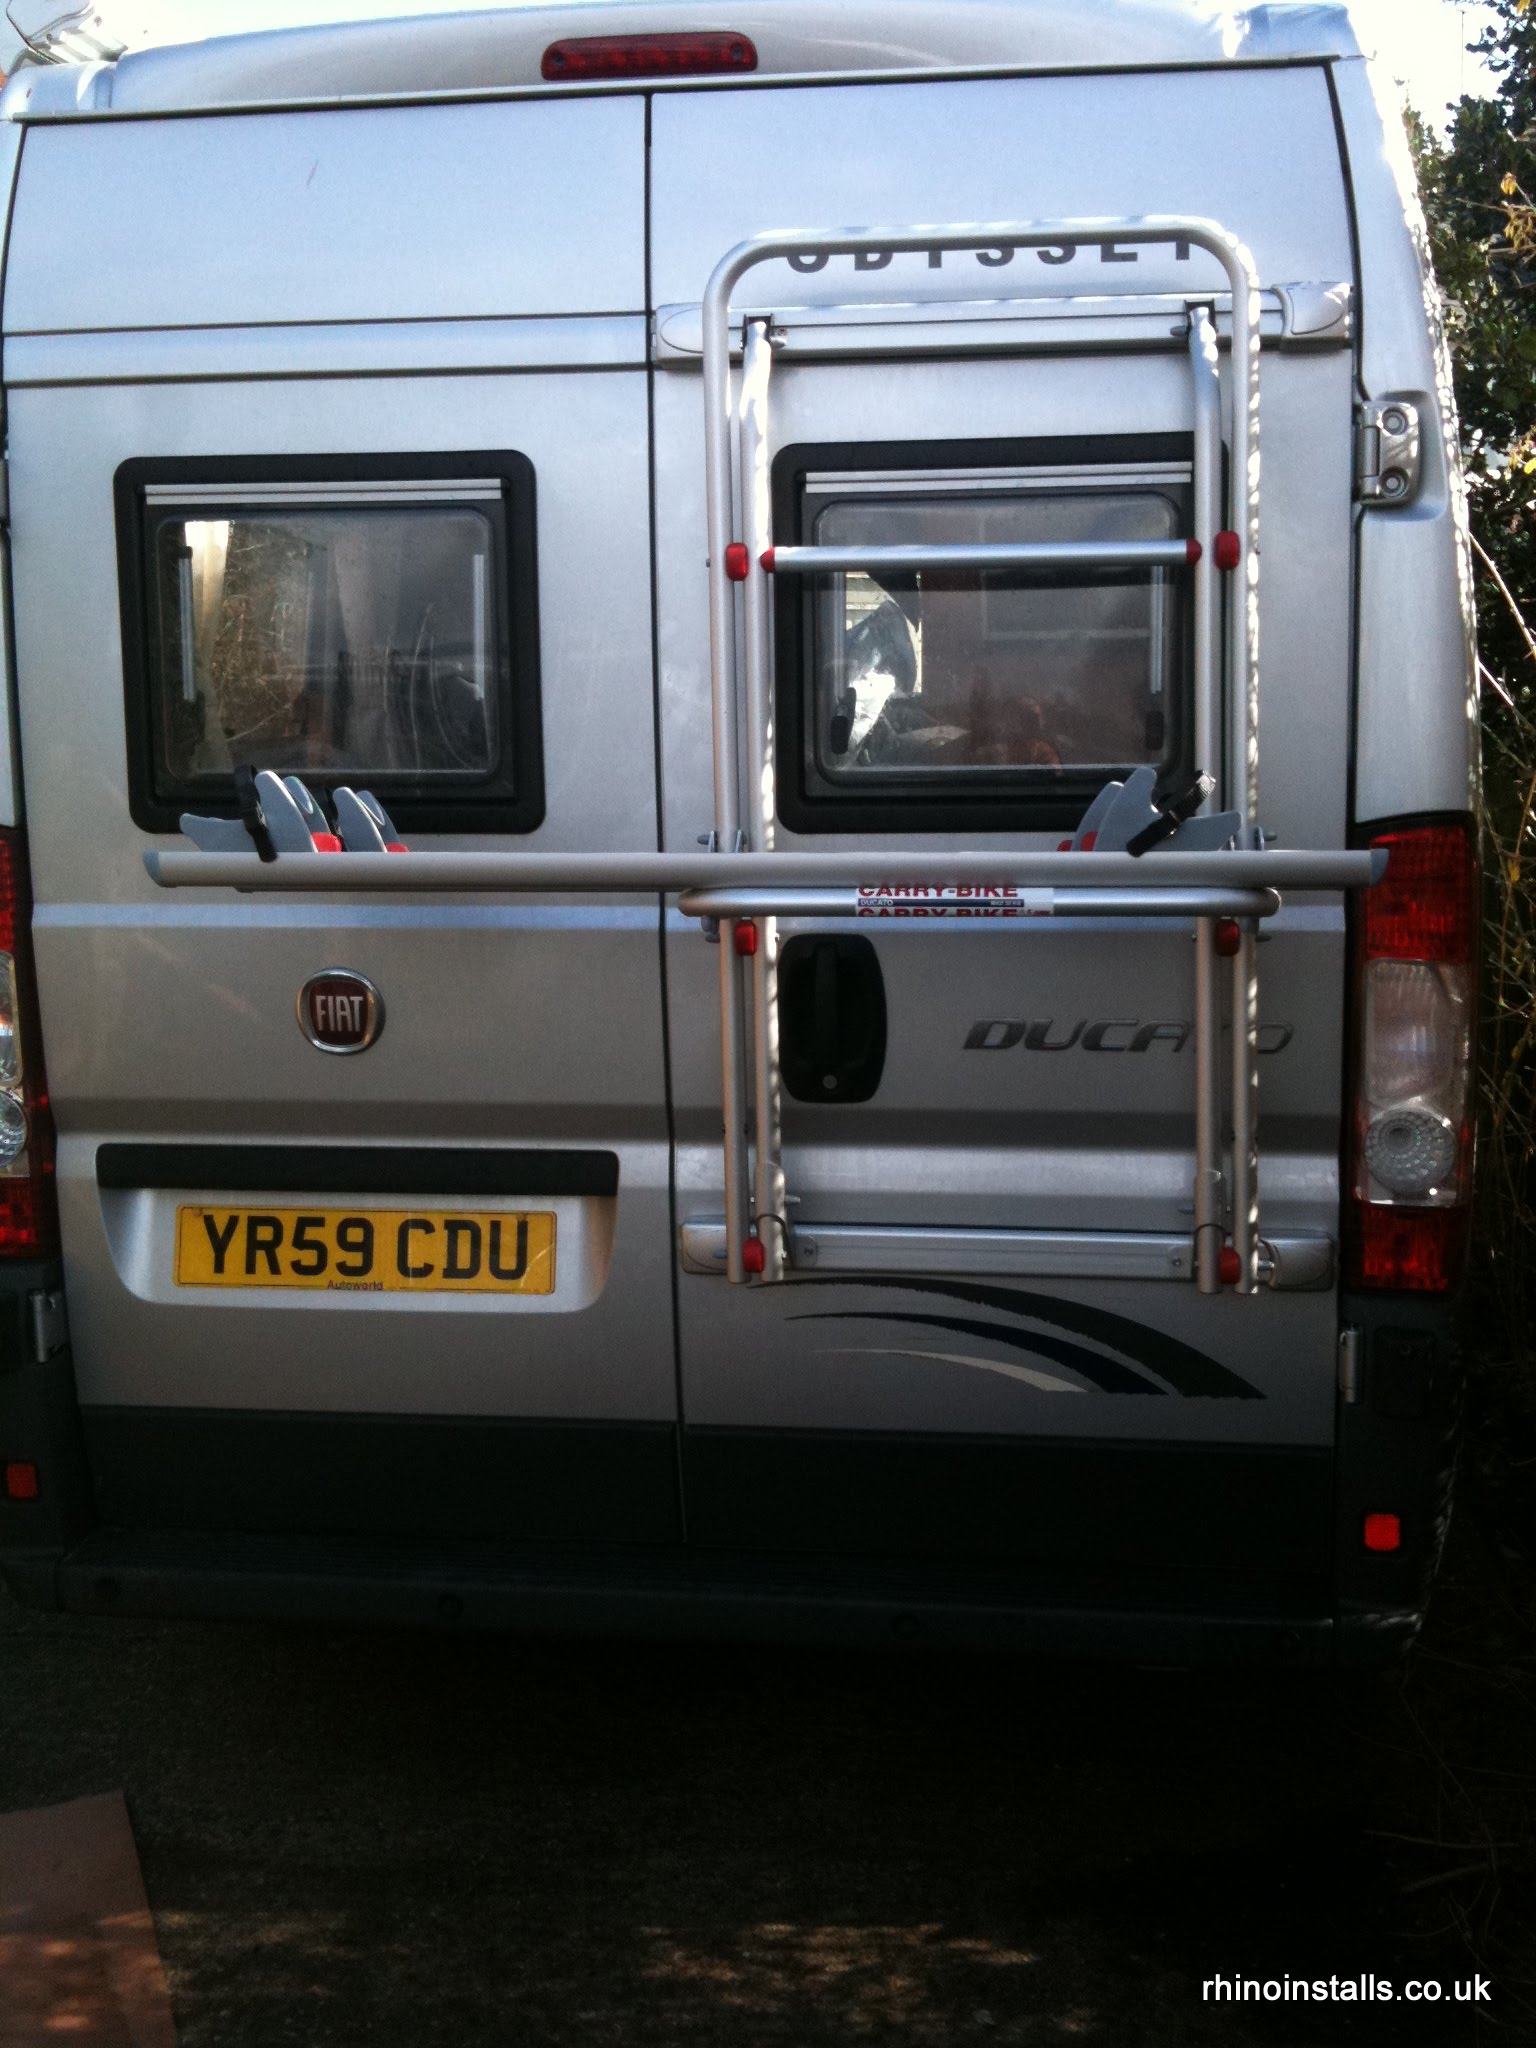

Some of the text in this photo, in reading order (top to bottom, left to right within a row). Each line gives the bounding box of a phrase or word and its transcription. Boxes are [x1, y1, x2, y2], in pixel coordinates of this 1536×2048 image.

[858, 885, 1018, 898] CARRY-BIKE
[315, 995, 364, 1032] FIAT
[963, 1017, 1294, 1054] DUCAO
[203, 1214, 529, 1281] YR59 CDU
[327, 1279, 384, 1291] Autoworld
